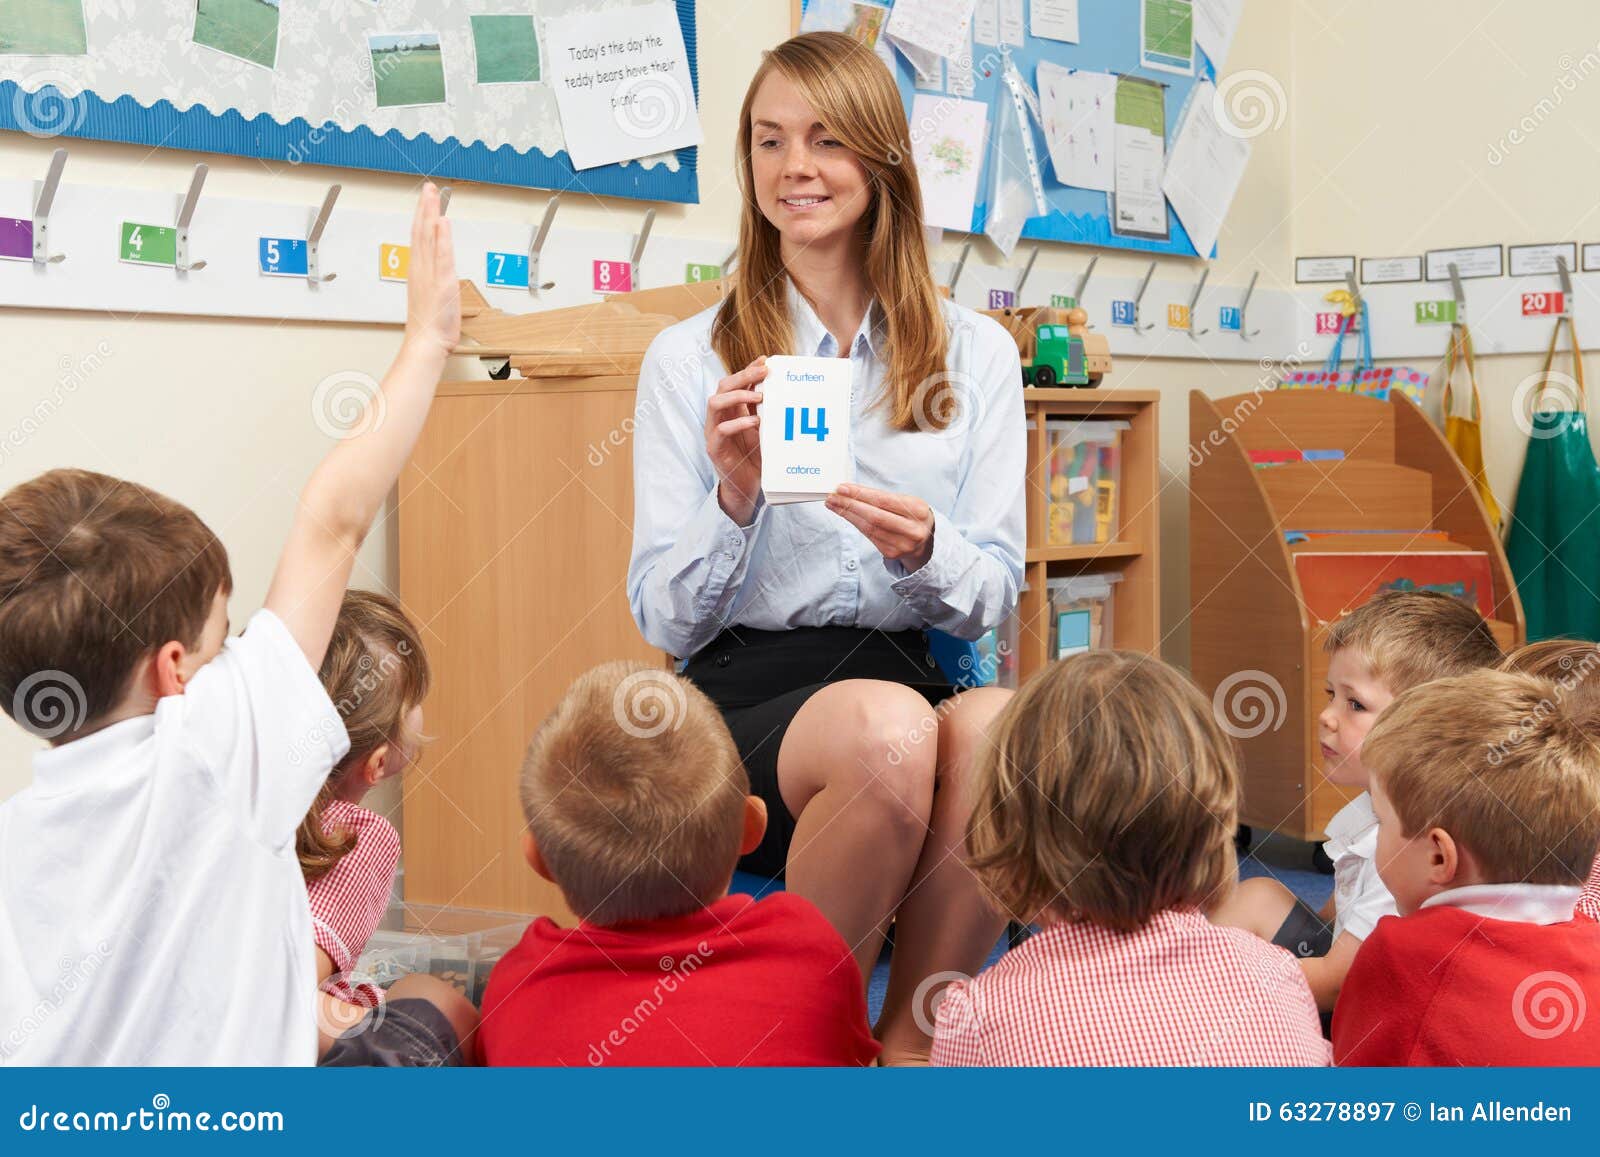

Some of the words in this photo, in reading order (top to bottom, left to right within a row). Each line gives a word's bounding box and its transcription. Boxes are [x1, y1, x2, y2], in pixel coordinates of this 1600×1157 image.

[567, 44, 605, 61] Today's
[608, 38, 625, 54] the
[626, 35, 643, 53] day
[644, 34, 663, 49] the
[564, 72, 594, 89] teddy
[625, 63, 649, 79] have
[650, 58, 676, 73] their
[129, 226, 143, 251] 4
[267, 239, 280, 265] 5
[388, 247, 400, 270] 6
[494, 254, 506, 276] 7
[599, 262, 611, 284] 8
[691, 265, 701, 283] 9
[991, 290, 1005, 309] 13
[1523, 294, 1547, 311] 20
[1113, 302, 1127, 319] 15
[1170, 306, 1183, 321] 16
[1221, 308, 1233, 323] 17
[1418, 302, 1438, 318] 19
[1319, 312, 1338, 329] 18
[786, 371, 824, 382] fourteen
[784, 407, 829, 442] 14
[786, 465, 821, 475] catorce
